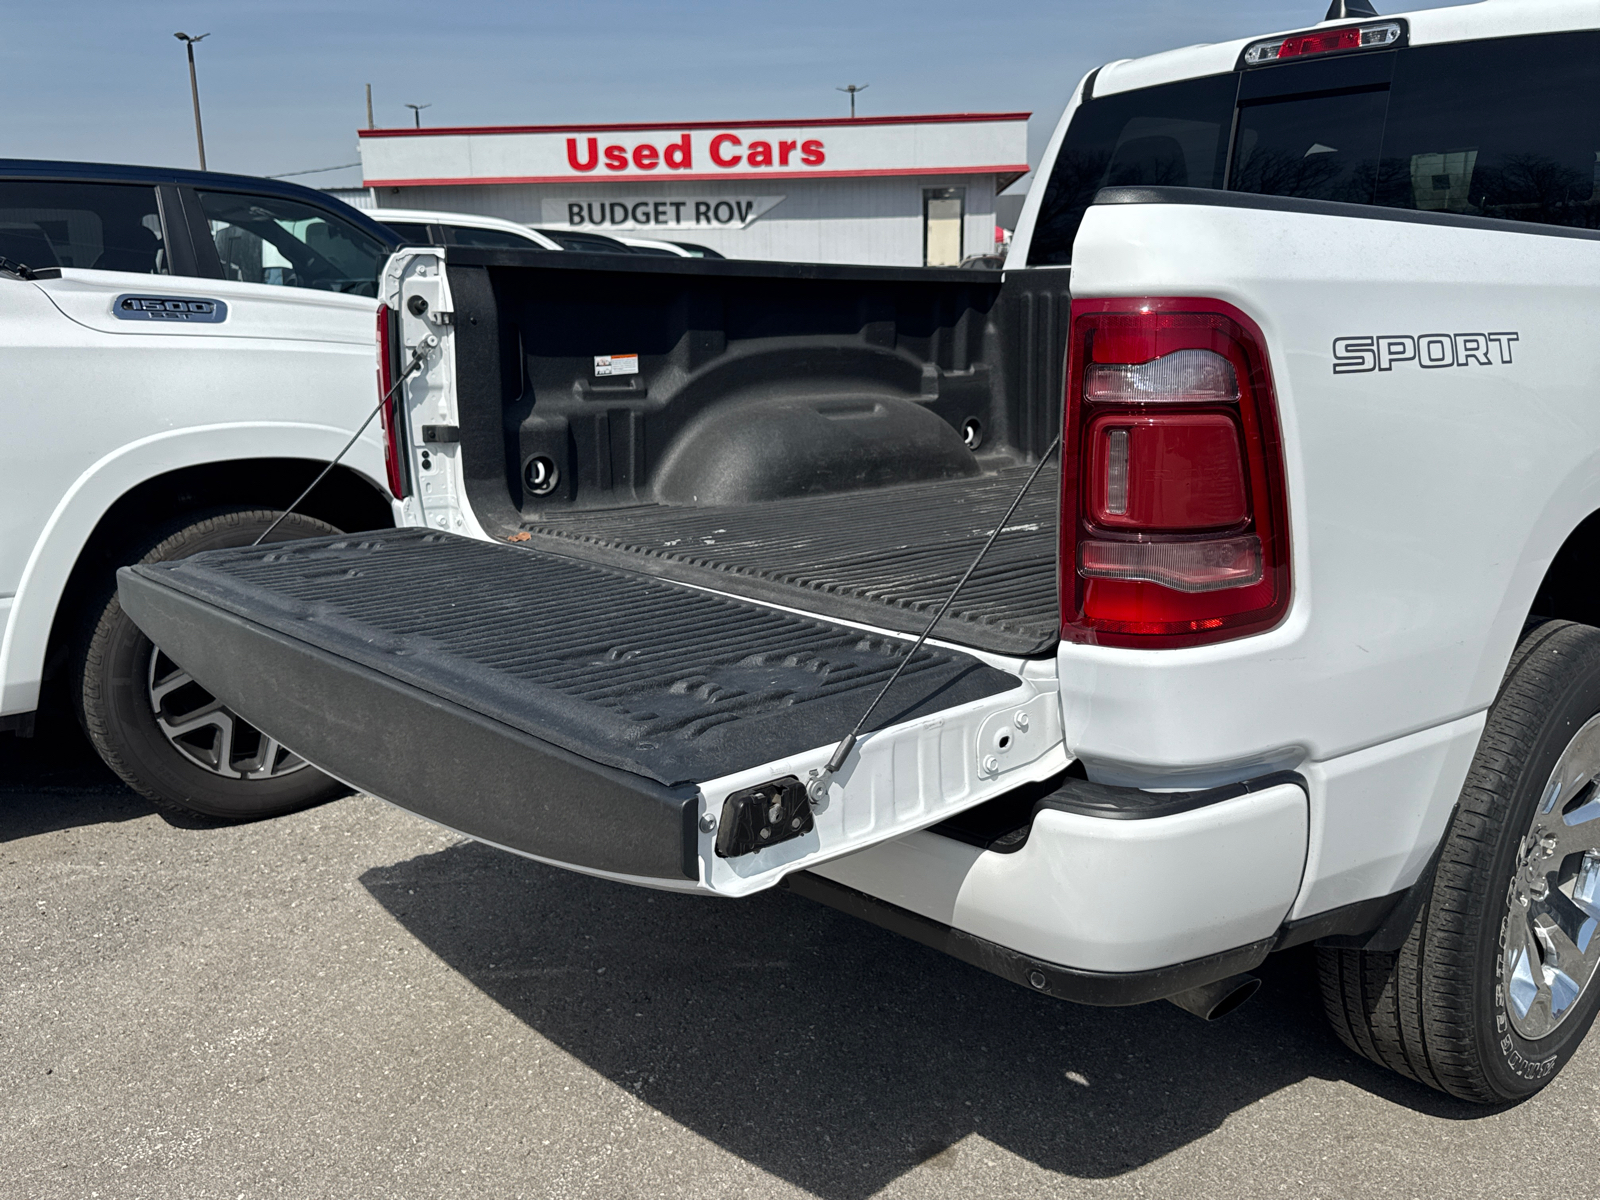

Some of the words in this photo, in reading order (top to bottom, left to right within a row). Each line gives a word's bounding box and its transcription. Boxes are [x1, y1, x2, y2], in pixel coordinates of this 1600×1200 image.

[566, 133, 693, 172] Used
[709, 133, 826, 168] Cars
[567, 201, 687, 226] BUDGET
[127, 298, 211, 313] 1500
[1333, 332, 1519, 374] SPORT
